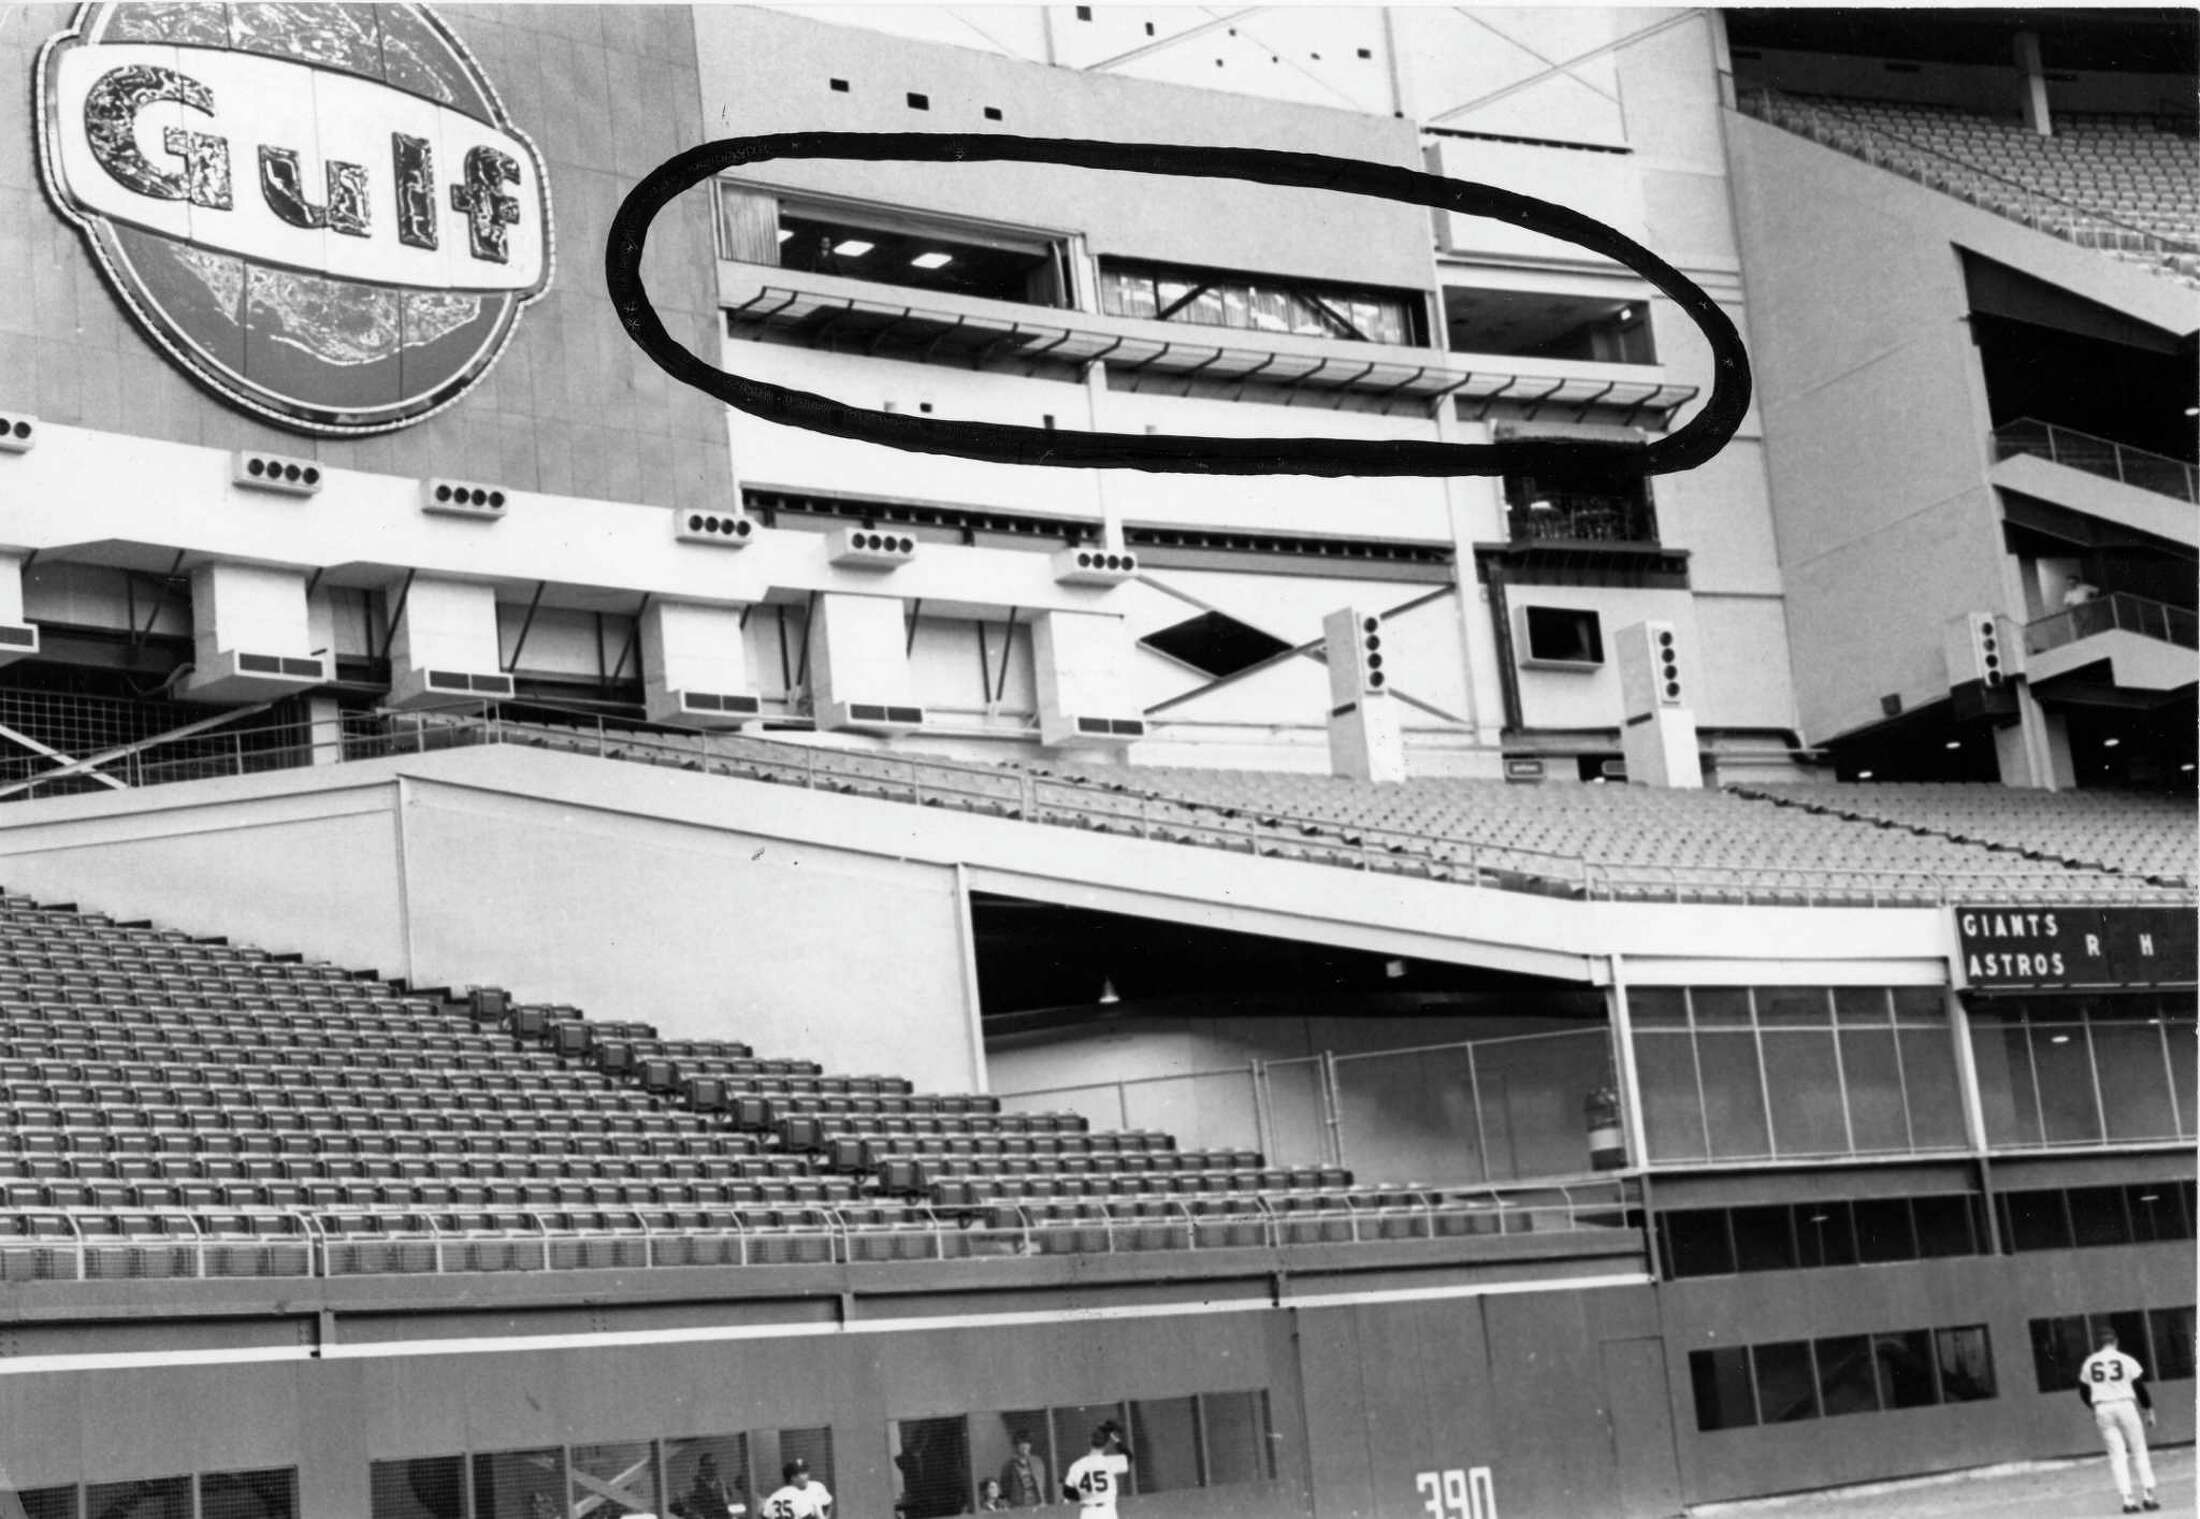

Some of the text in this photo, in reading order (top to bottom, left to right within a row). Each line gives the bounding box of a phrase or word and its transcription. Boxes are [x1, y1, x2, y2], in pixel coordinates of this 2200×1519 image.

[84, 64, 521, 265] Gulf
[1962, 913, 2059, 938] GIANTS
[2085, 933, 2154, 957] R H
[1969, 953, 2065, 977] ASTROS
[2090, 1360, 2124, 1383] 63
[1080, 1470, 1108, 1493] 45
[1416, 1466, 1498, 1519] 390
[772, 1499, 795, 1519] 35
